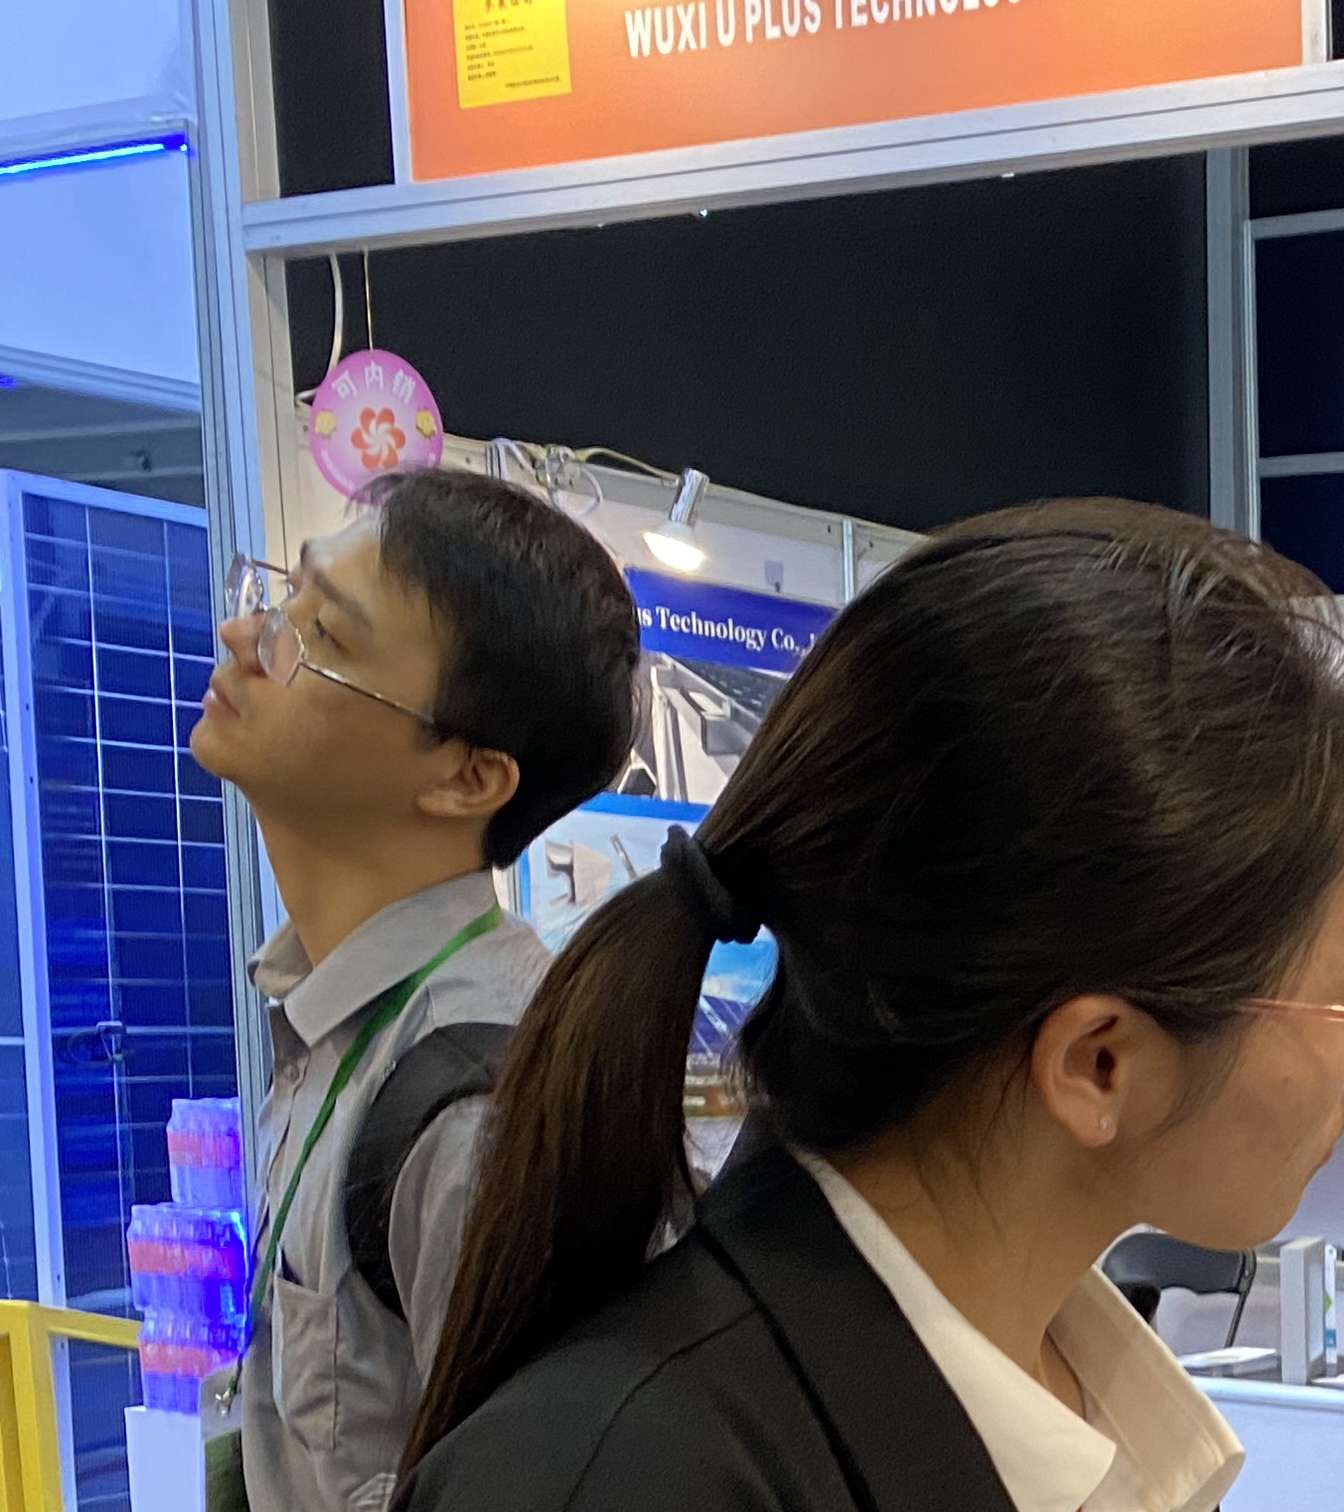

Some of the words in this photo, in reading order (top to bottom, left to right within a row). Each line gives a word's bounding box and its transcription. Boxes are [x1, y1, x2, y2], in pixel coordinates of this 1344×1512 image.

[624, 2, 707, 58] WUXI
[716, 0, 736, 47] U
[744, 0, 821, 43] PLUS
[656, 605, 768, 652] Technology
